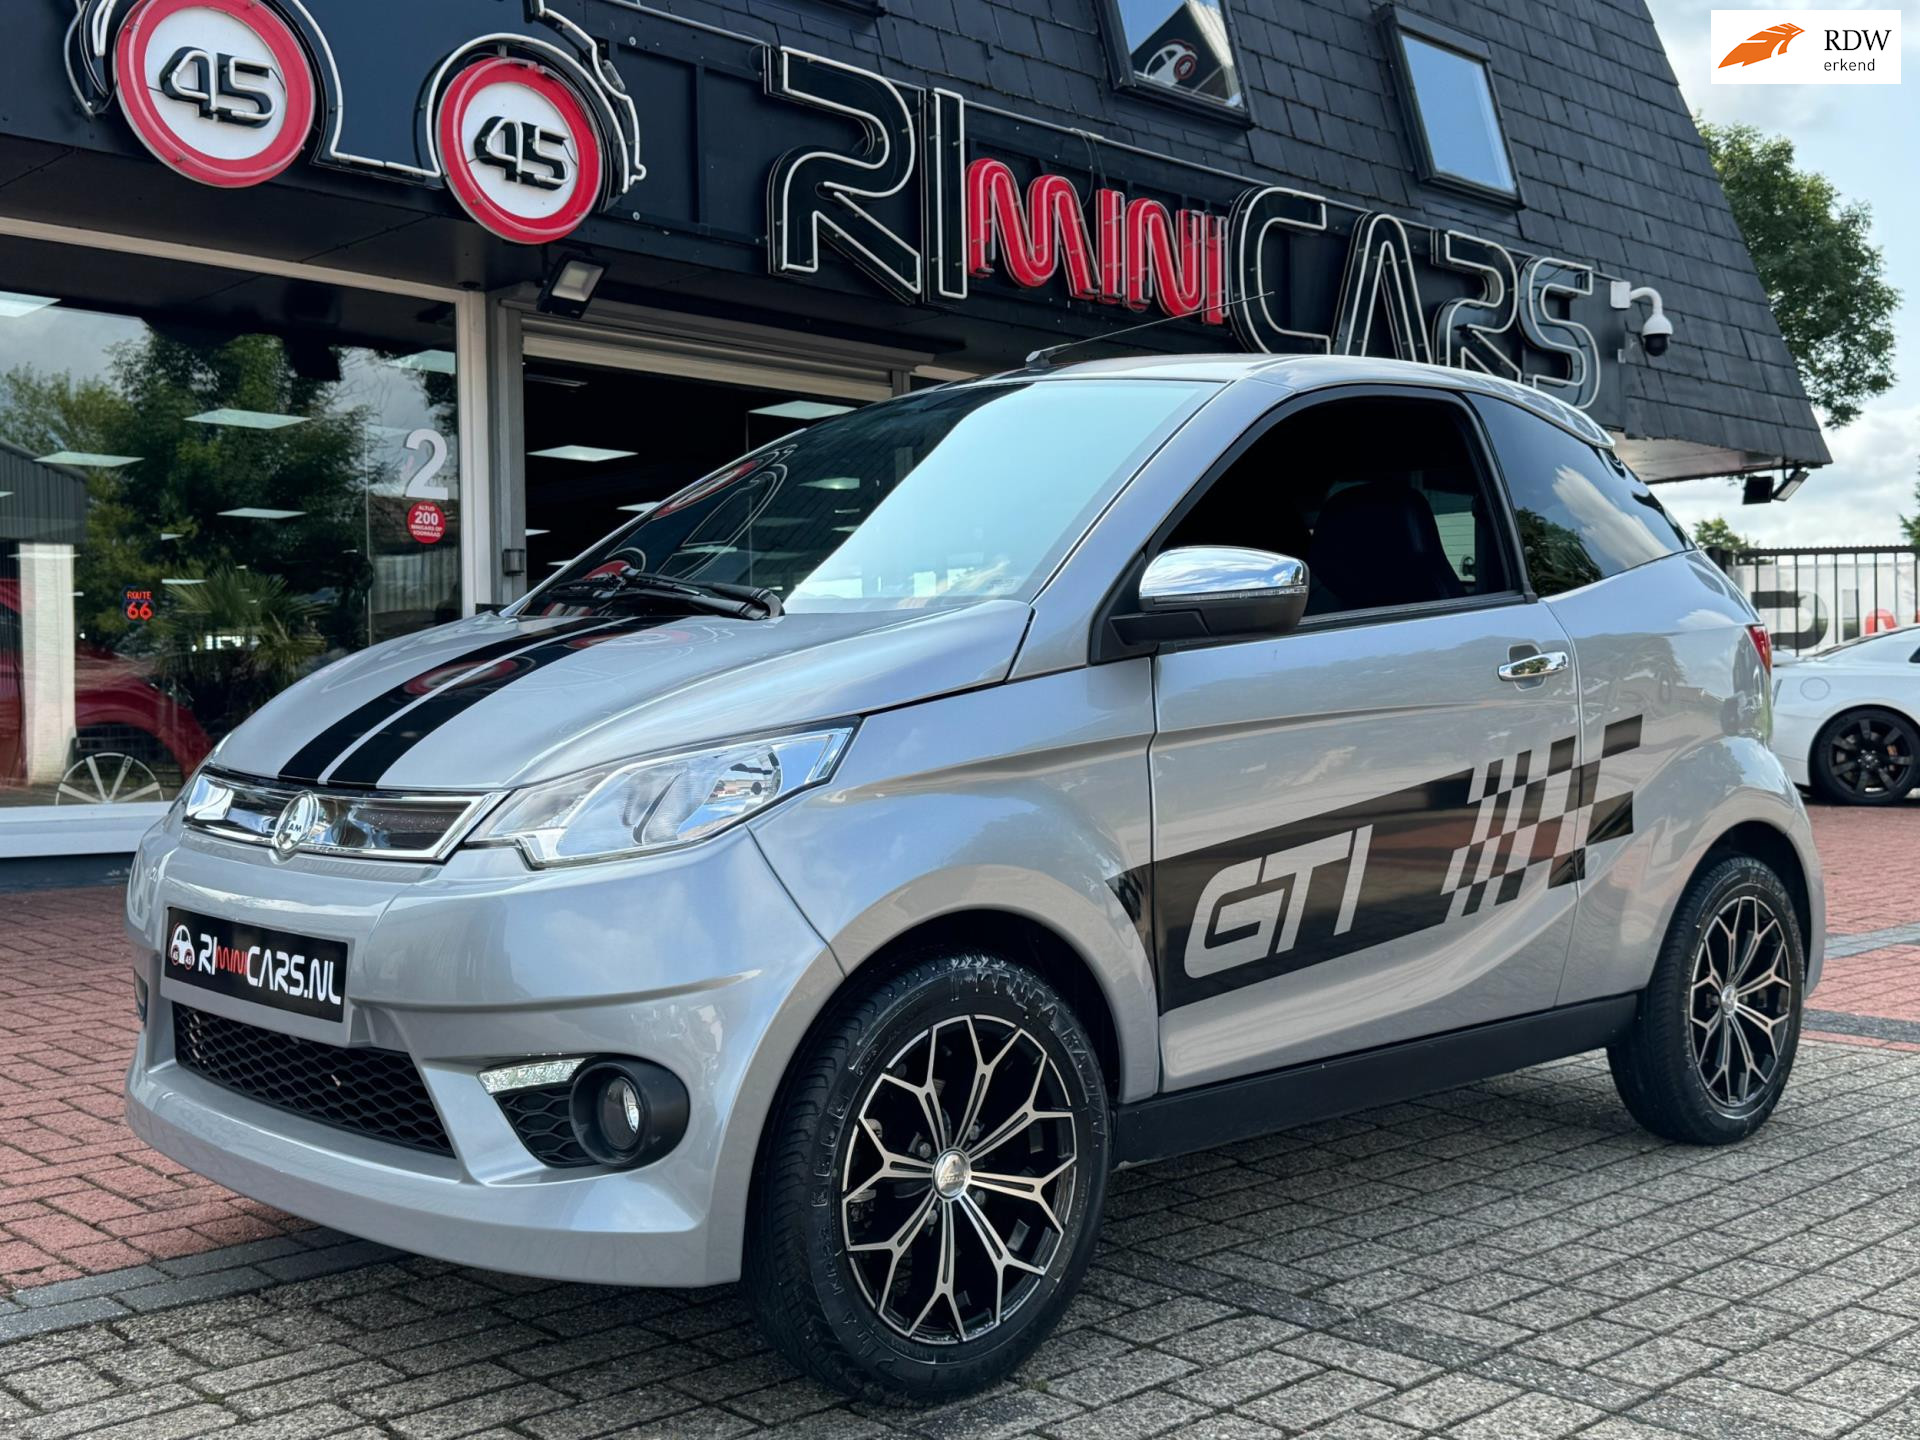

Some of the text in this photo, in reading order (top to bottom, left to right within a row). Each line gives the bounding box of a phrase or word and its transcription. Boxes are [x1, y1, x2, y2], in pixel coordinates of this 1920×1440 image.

[158, 46, 278, 129] 45
[473, 115, 576, 191] 45
[404, 428, 449, 501] 2
[414, 510, 439, 526] 200
[127, 590, 152, 600] ROUTE
[127, 601, 153, 621] 66
[1183, 824, 1373, 979] GTI
